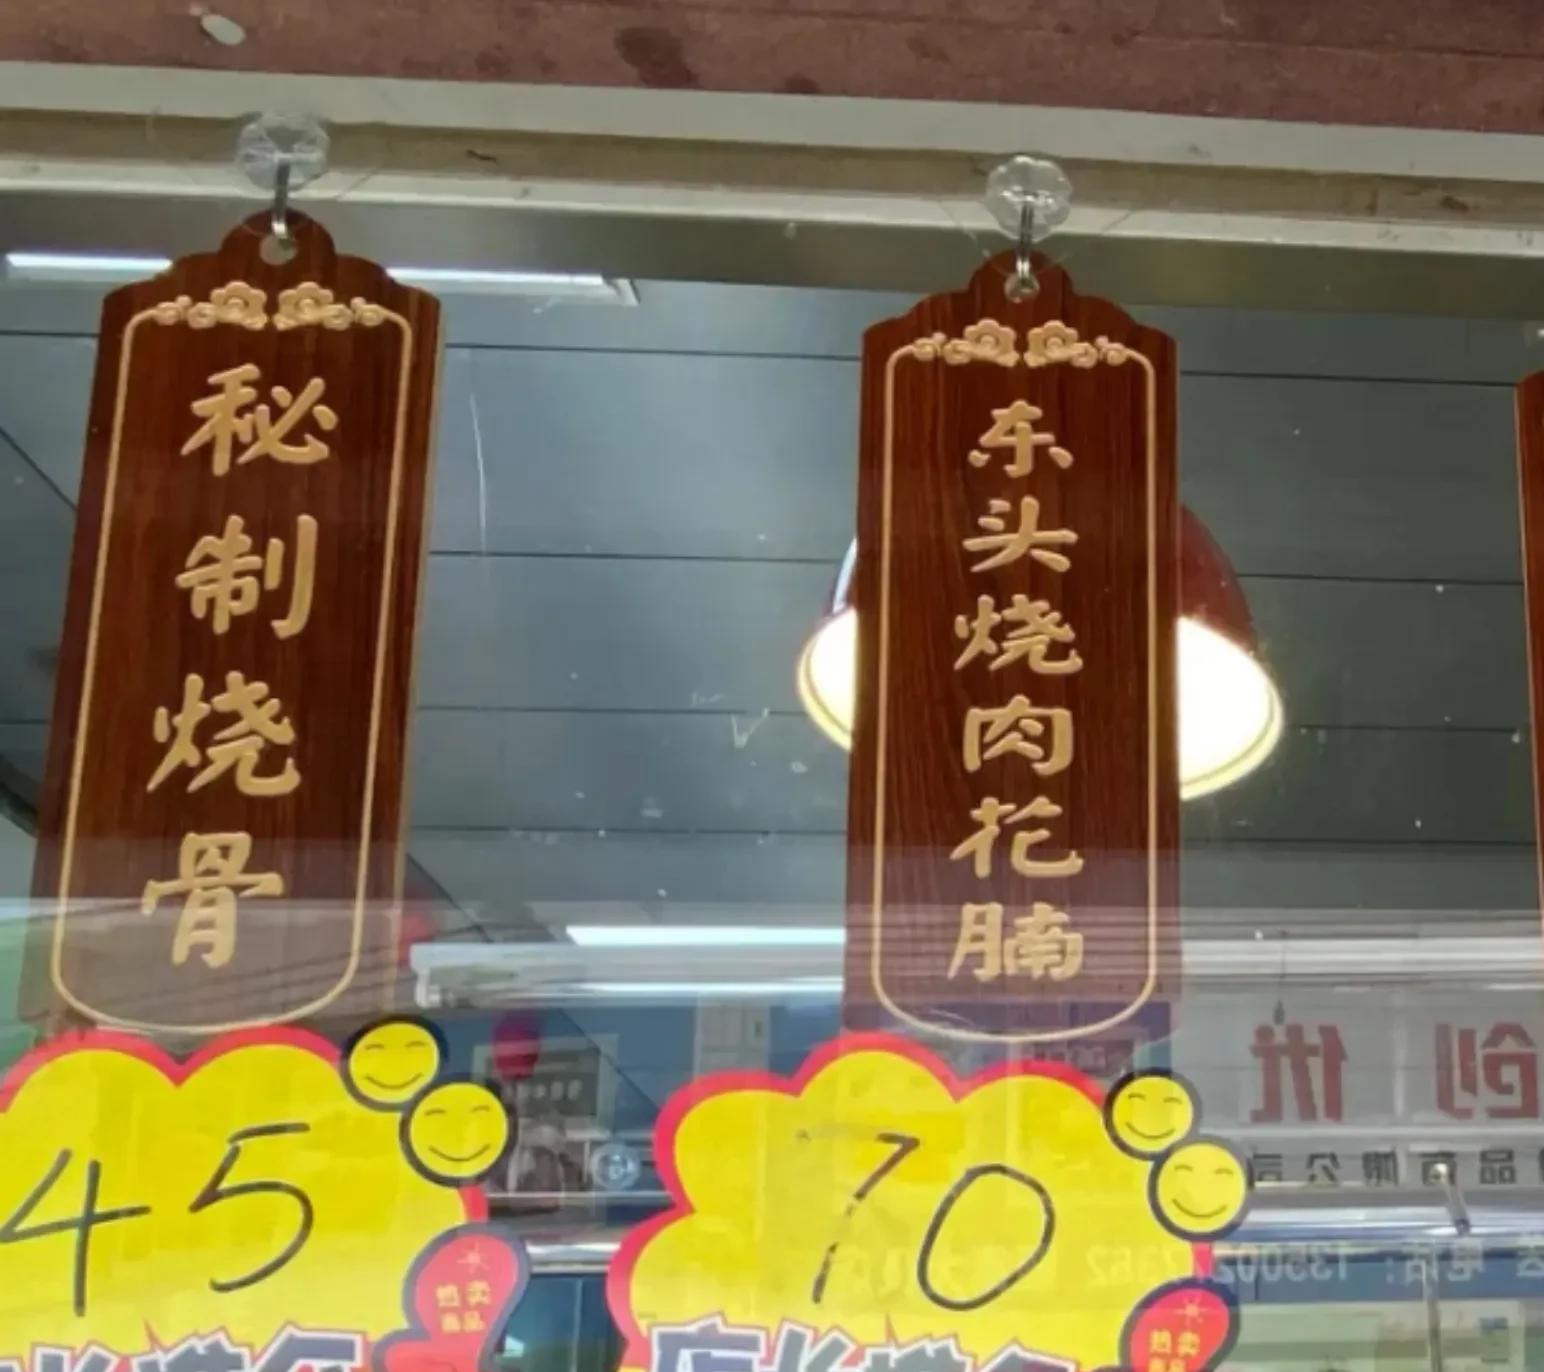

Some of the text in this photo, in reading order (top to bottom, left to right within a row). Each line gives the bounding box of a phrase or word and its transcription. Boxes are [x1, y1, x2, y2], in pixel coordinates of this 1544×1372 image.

[141, 363, 339, 969] 秘制烧骨
[947, 399, 1085, 982] 东头烧肉花腩
[0, 1121, 314, 1317] 45
[794, 1128, 1056, 1312] 70
